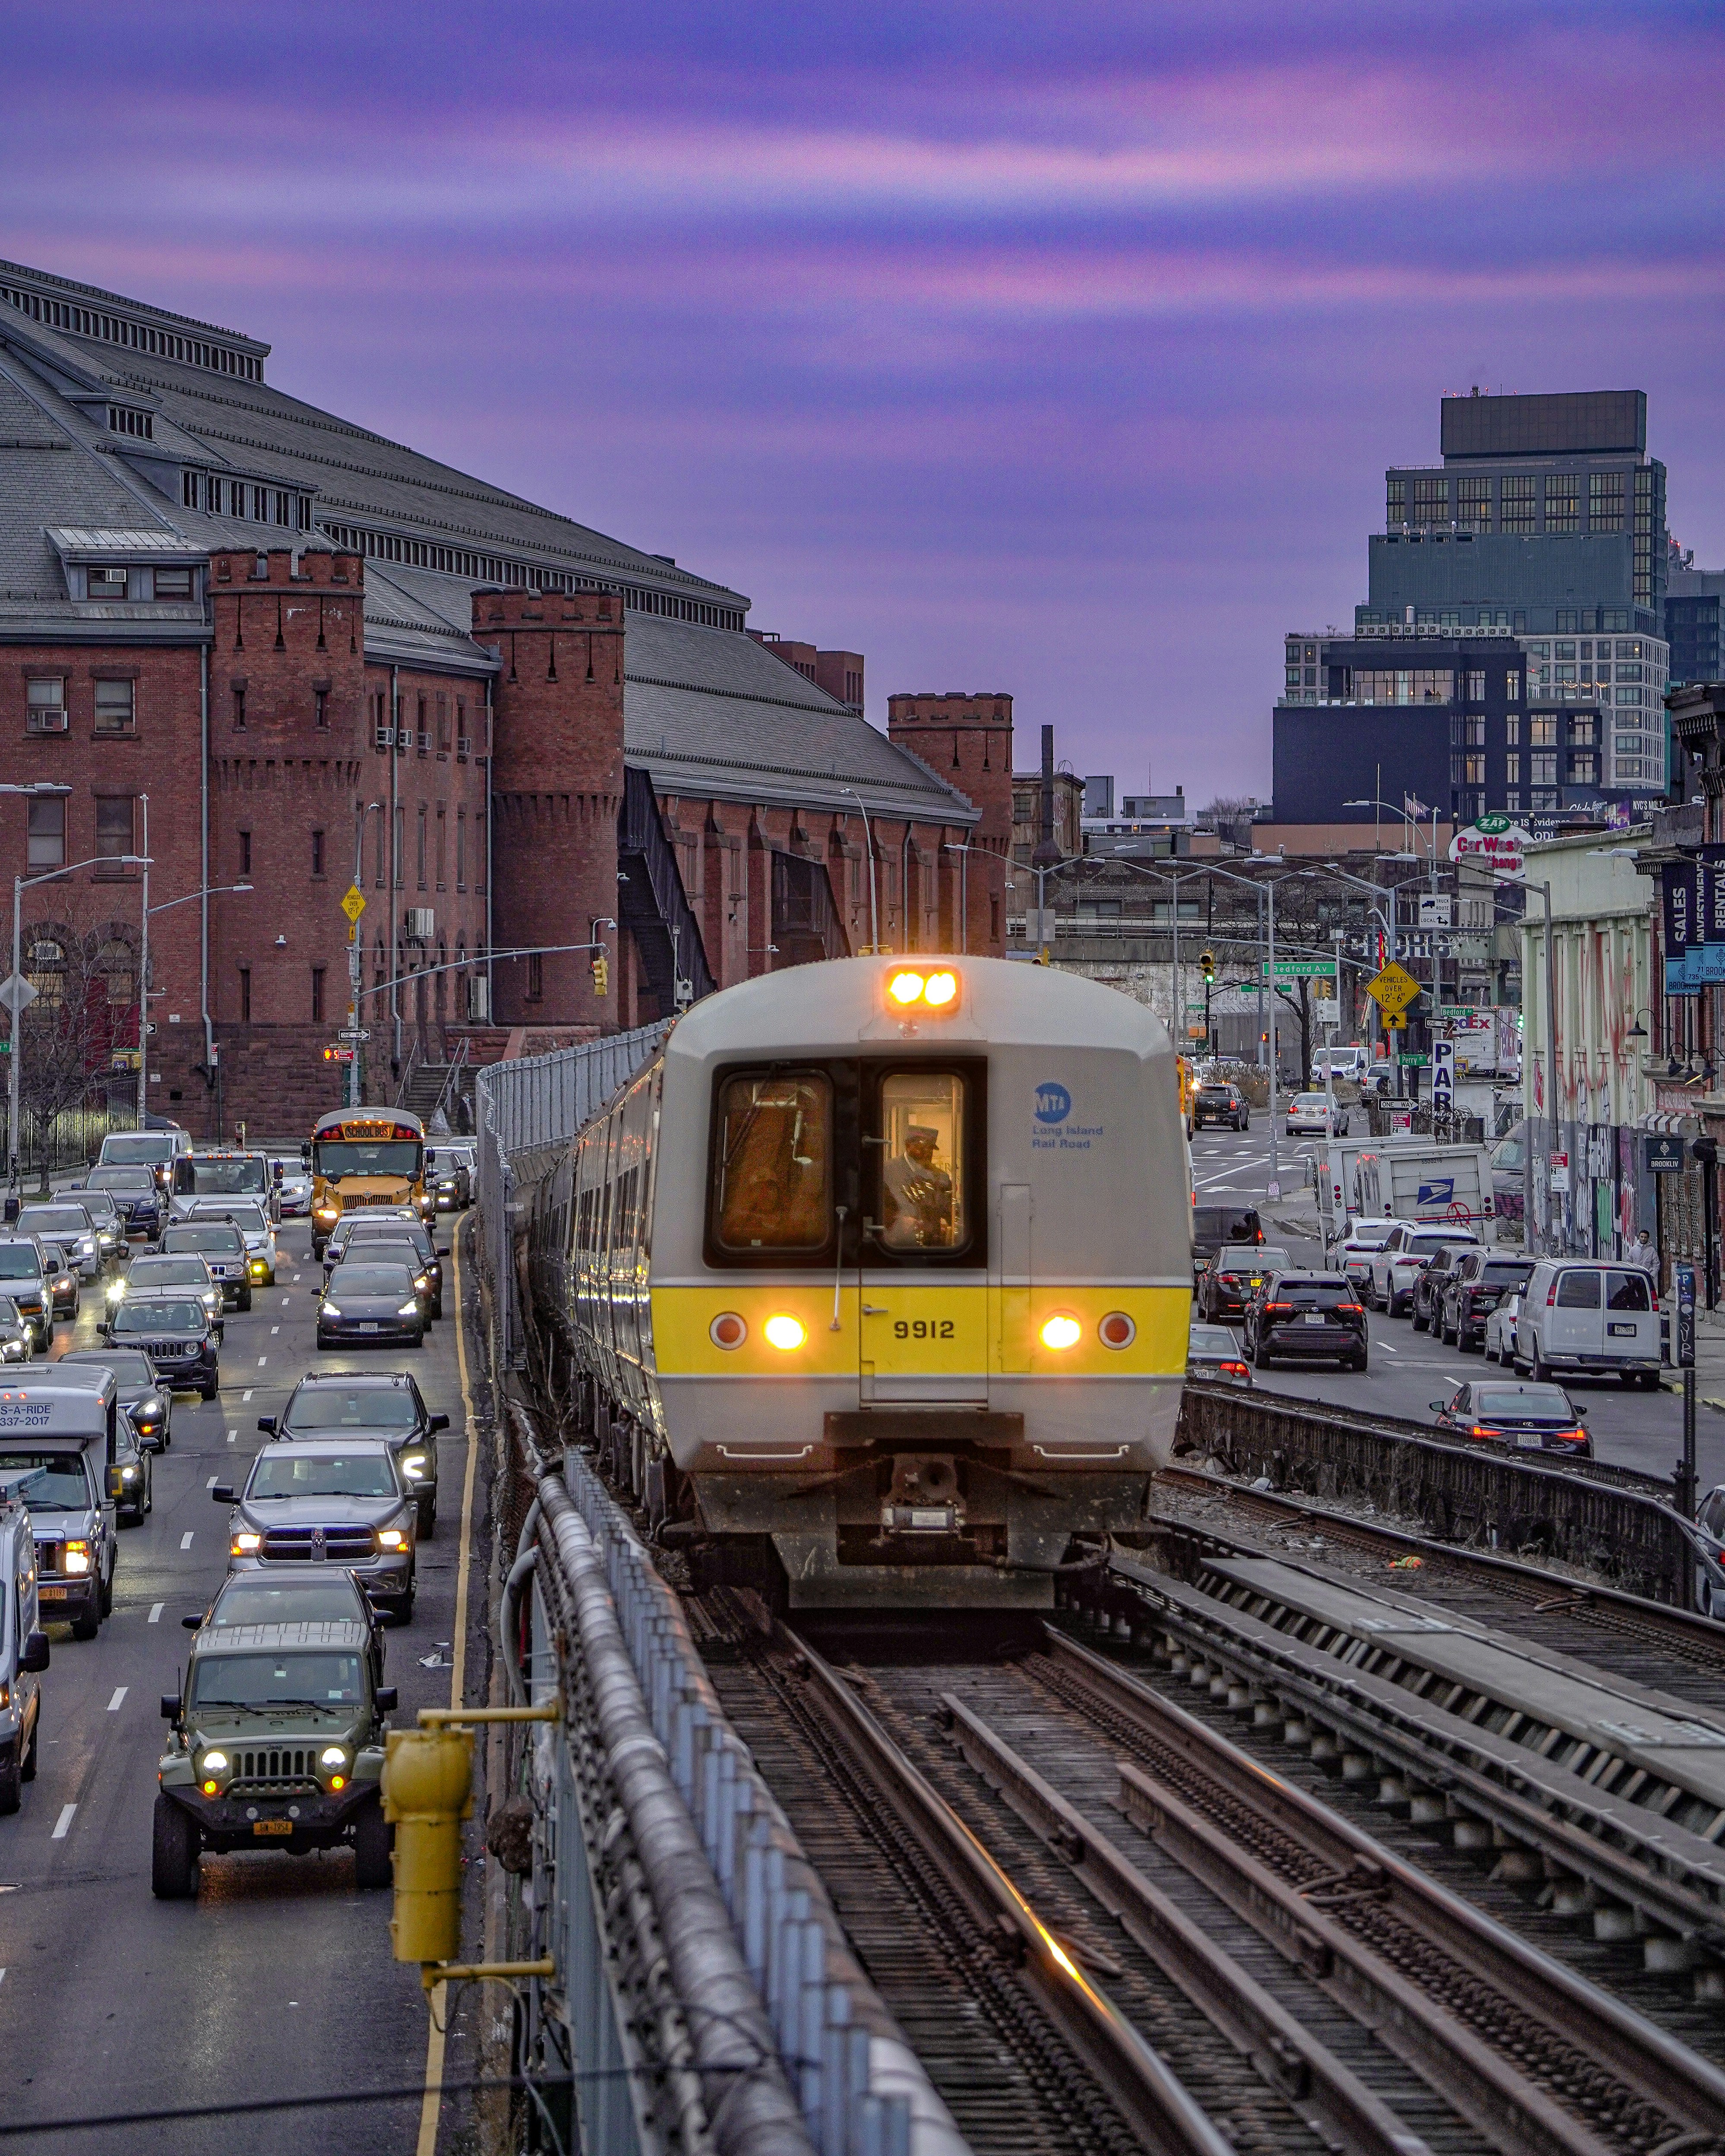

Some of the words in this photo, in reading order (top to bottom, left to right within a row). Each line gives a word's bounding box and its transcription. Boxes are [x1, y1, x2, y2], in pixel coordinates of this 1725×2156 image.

[1633, 800, 1648, 810] NYC'S
[1649, 800, 1663, 810] MOT
[1643, 811, 1653, 820] OPE
[1479, 818, 1507, 827] ZAP
[1520, 818, 1530, 826] IS
[1457, 837, 1482, 852] Car
[1483, 837, 1523, 852] Wash
[1484, 855, 1523, 871] Change
[1696, 853, 1704, 942] INVESTMENTS
[1672, 887, 1686, 942] SALES
[1381, 993, 1405, 1002] 12'-6"
[1402, 1056, 1417, 1065] Perry
[346, 1126, 373, 1137] SCHOOL
[375, 1126, 389, 1137] BUS
[1033, 1126, 1062, 1136] Long
[1066, 1126, 1103, 1135] Island
[1032, 1139, 1056, 1148] Rail
[1060, 1139, 1090, 1148] Road
[1682, 1274, 1689, 1284] P
[893, 1321, 954, 1339] 9912
